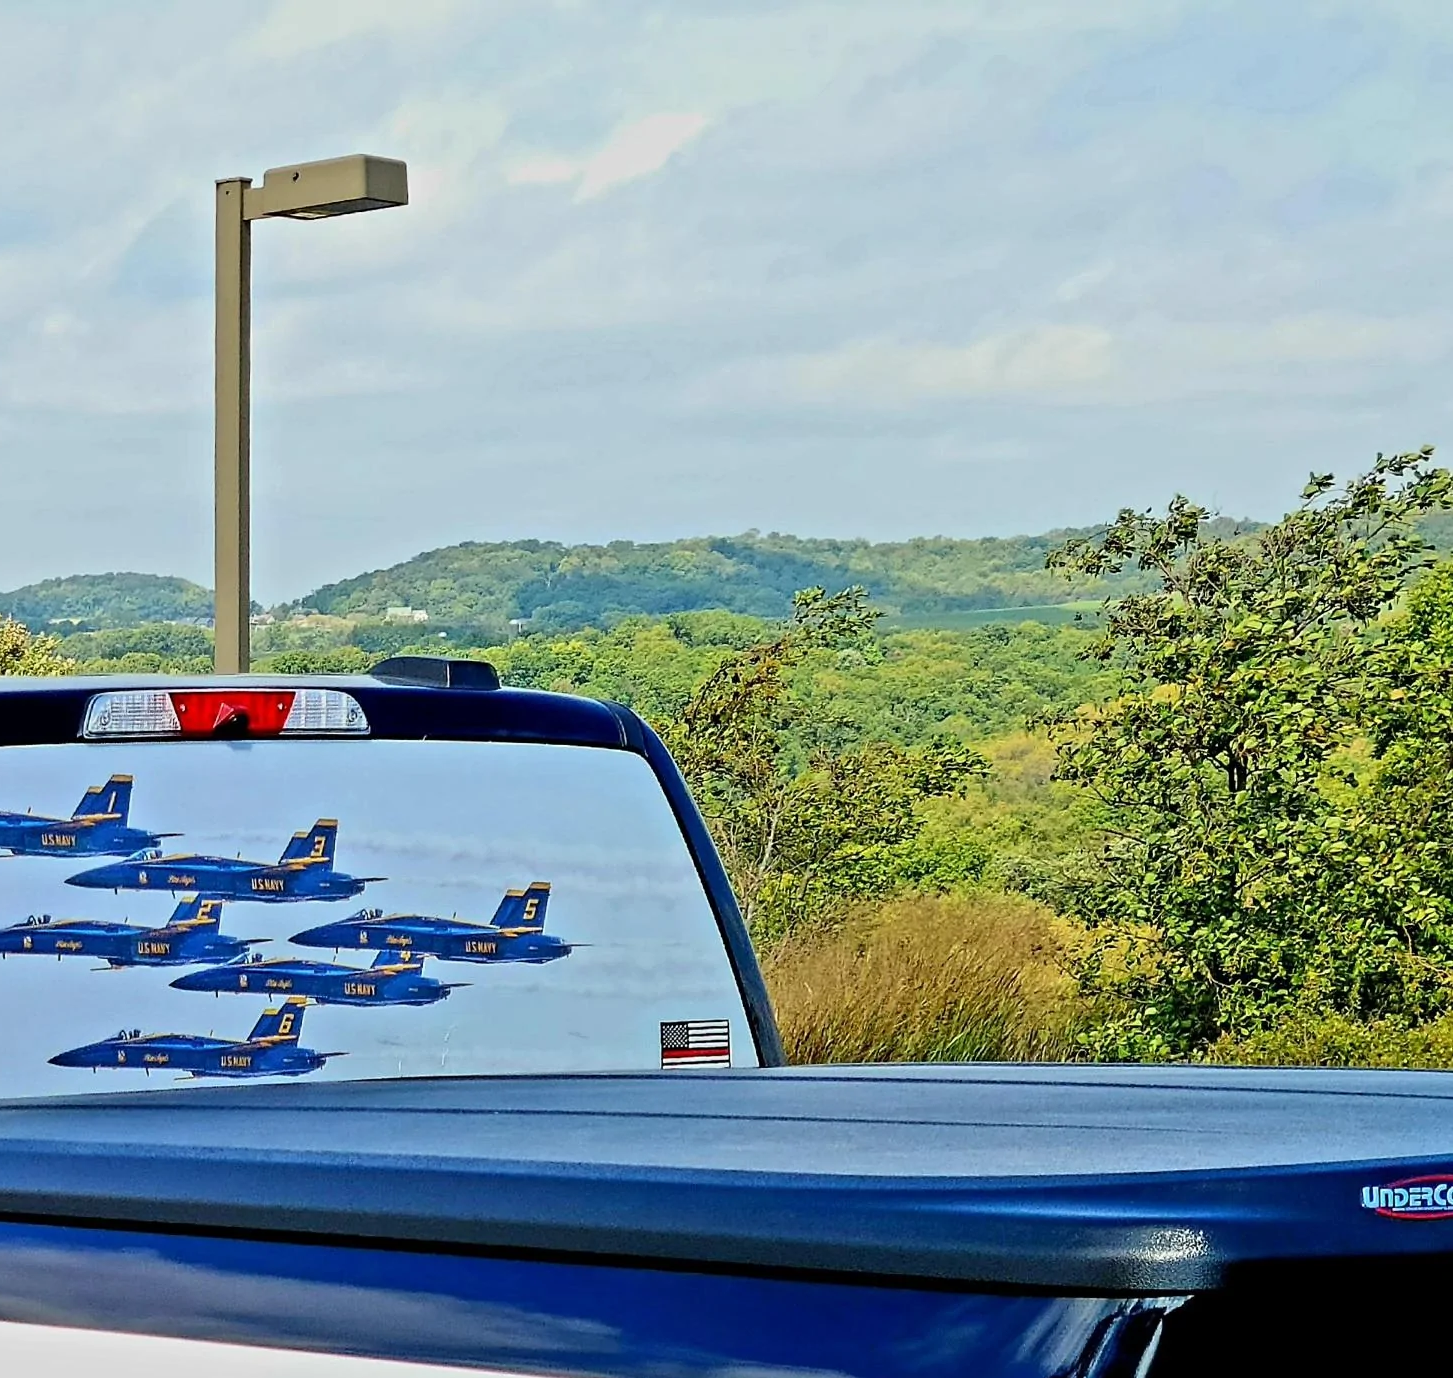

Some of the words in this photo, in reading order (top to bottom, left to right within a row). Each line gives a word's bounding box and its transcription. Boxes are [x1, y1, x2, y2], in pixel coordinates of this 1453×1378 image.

[55, 834, 76, 847] NAVY
[310, 836, 326, 857] 3
[265, 879, 284, 891] NAVY
[523, 899, 539, 920] 5
[150, 942, 170, 954] NAVY
[477, 941, 496, 954] NAVY
[357, 983, 376, 996] NAVY
[279, 1013, 295, 1034] 6
[233, 1056, 252, 1068] NAVY
